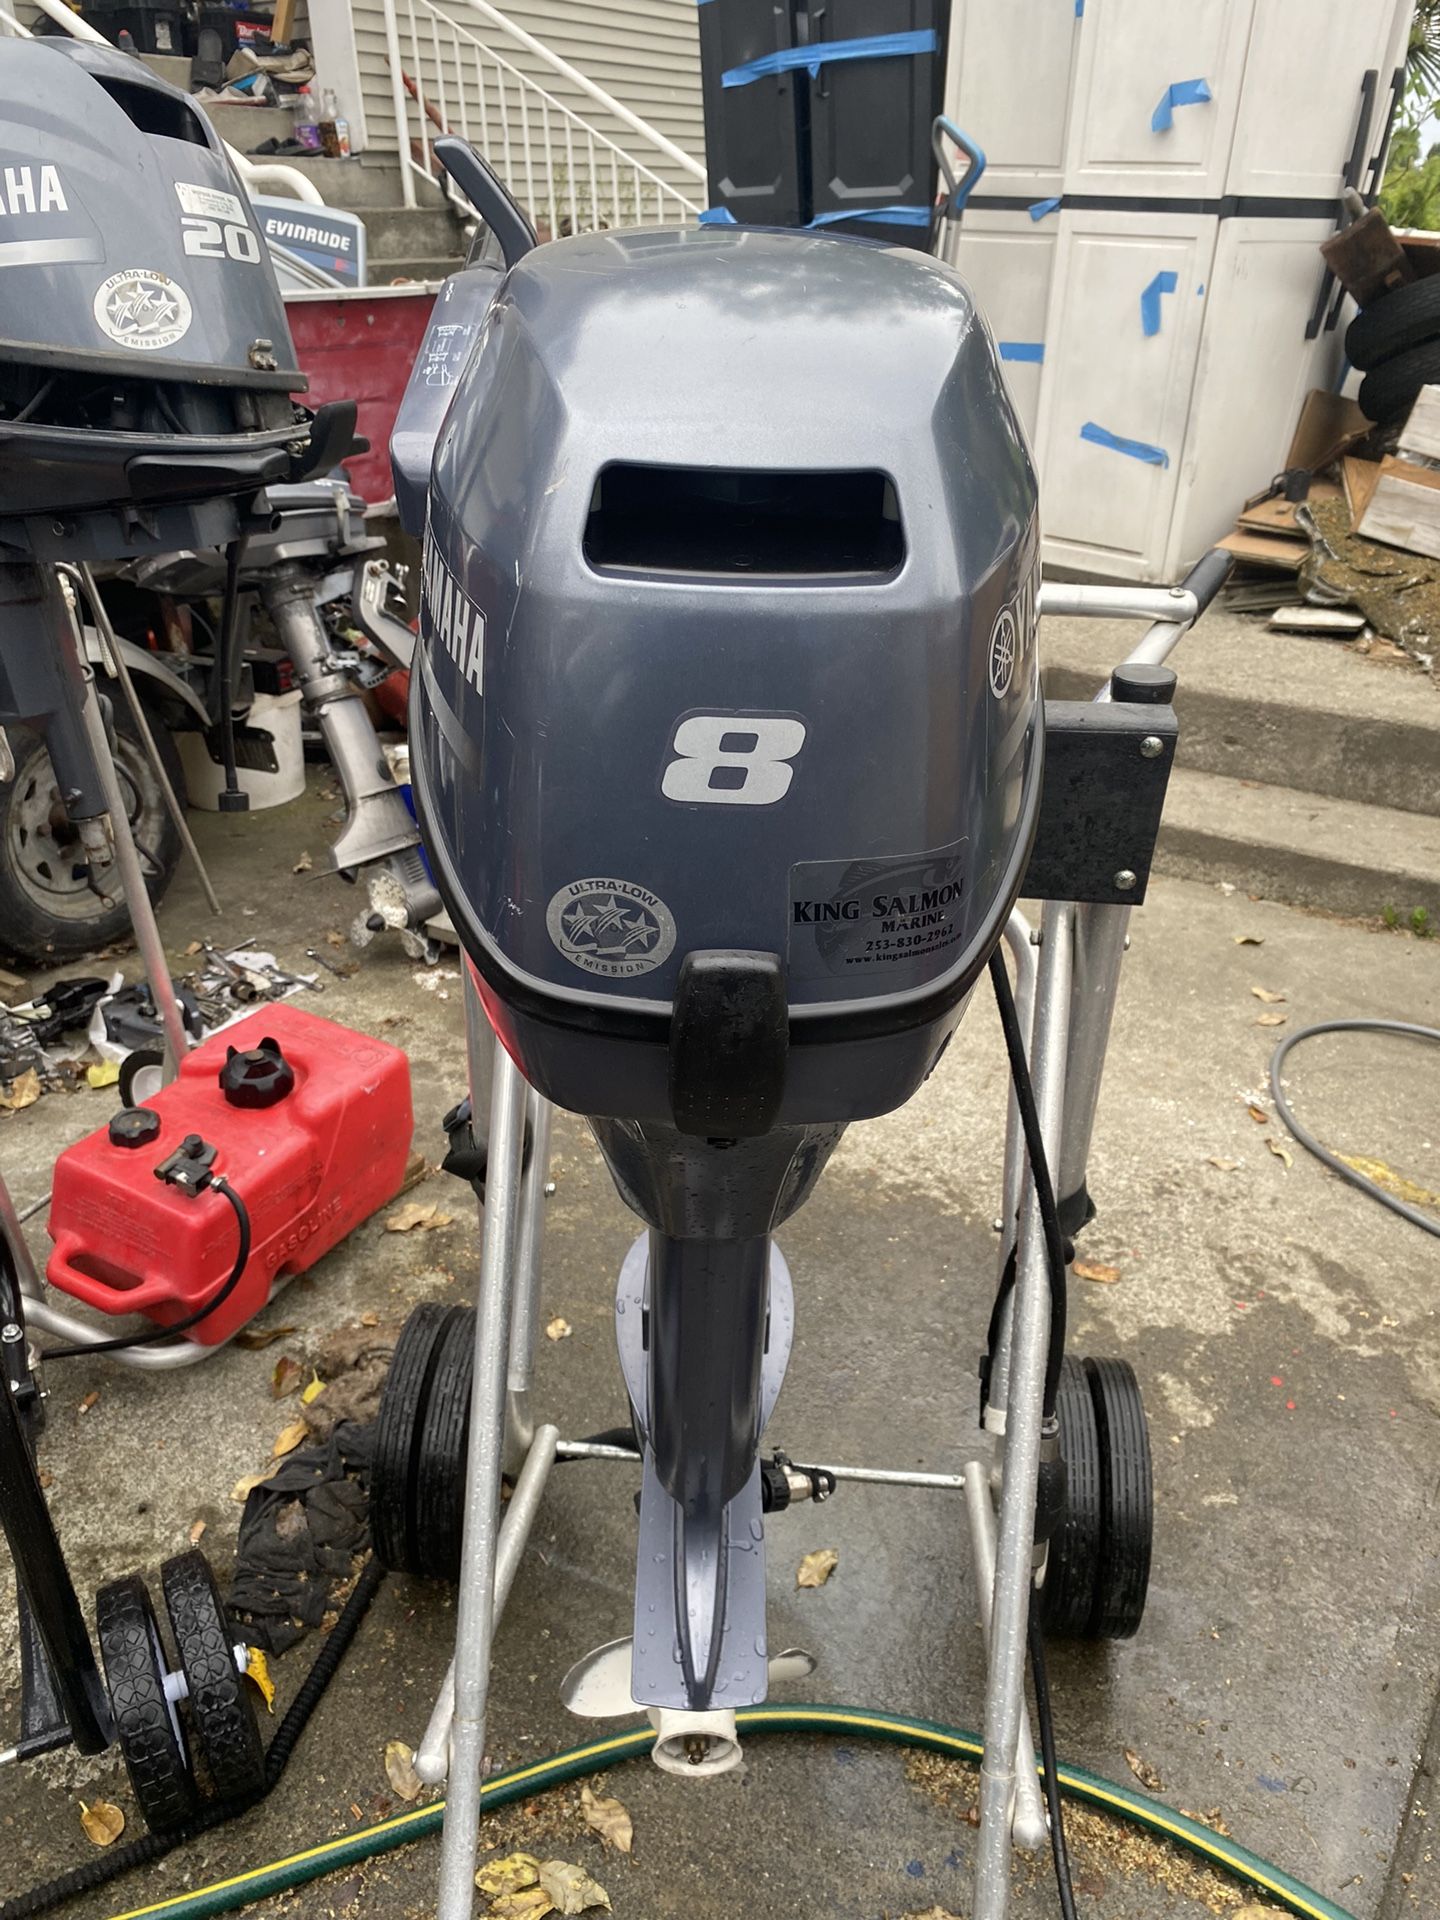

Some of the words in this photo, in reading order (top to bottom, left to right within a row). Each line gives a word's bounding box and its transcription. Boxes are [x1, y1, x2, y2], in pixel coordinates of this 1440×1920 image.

[0, 165, 69, 215] HA
[181, 217, 261, 264] 20
[265, 219, 351, 251] EVINRUDE
[661, 716, 806, 805] 8
[793, 901, 860, 924] KING
[872, 878, 964, 918] SALMON
[881, 909, 946, 933] MARINE
[866, 923, 953, 951] 253-830-2962
[574, 953, 645, 974] EMISSION
[266, 1196, 342, 1269] GASOLINE
